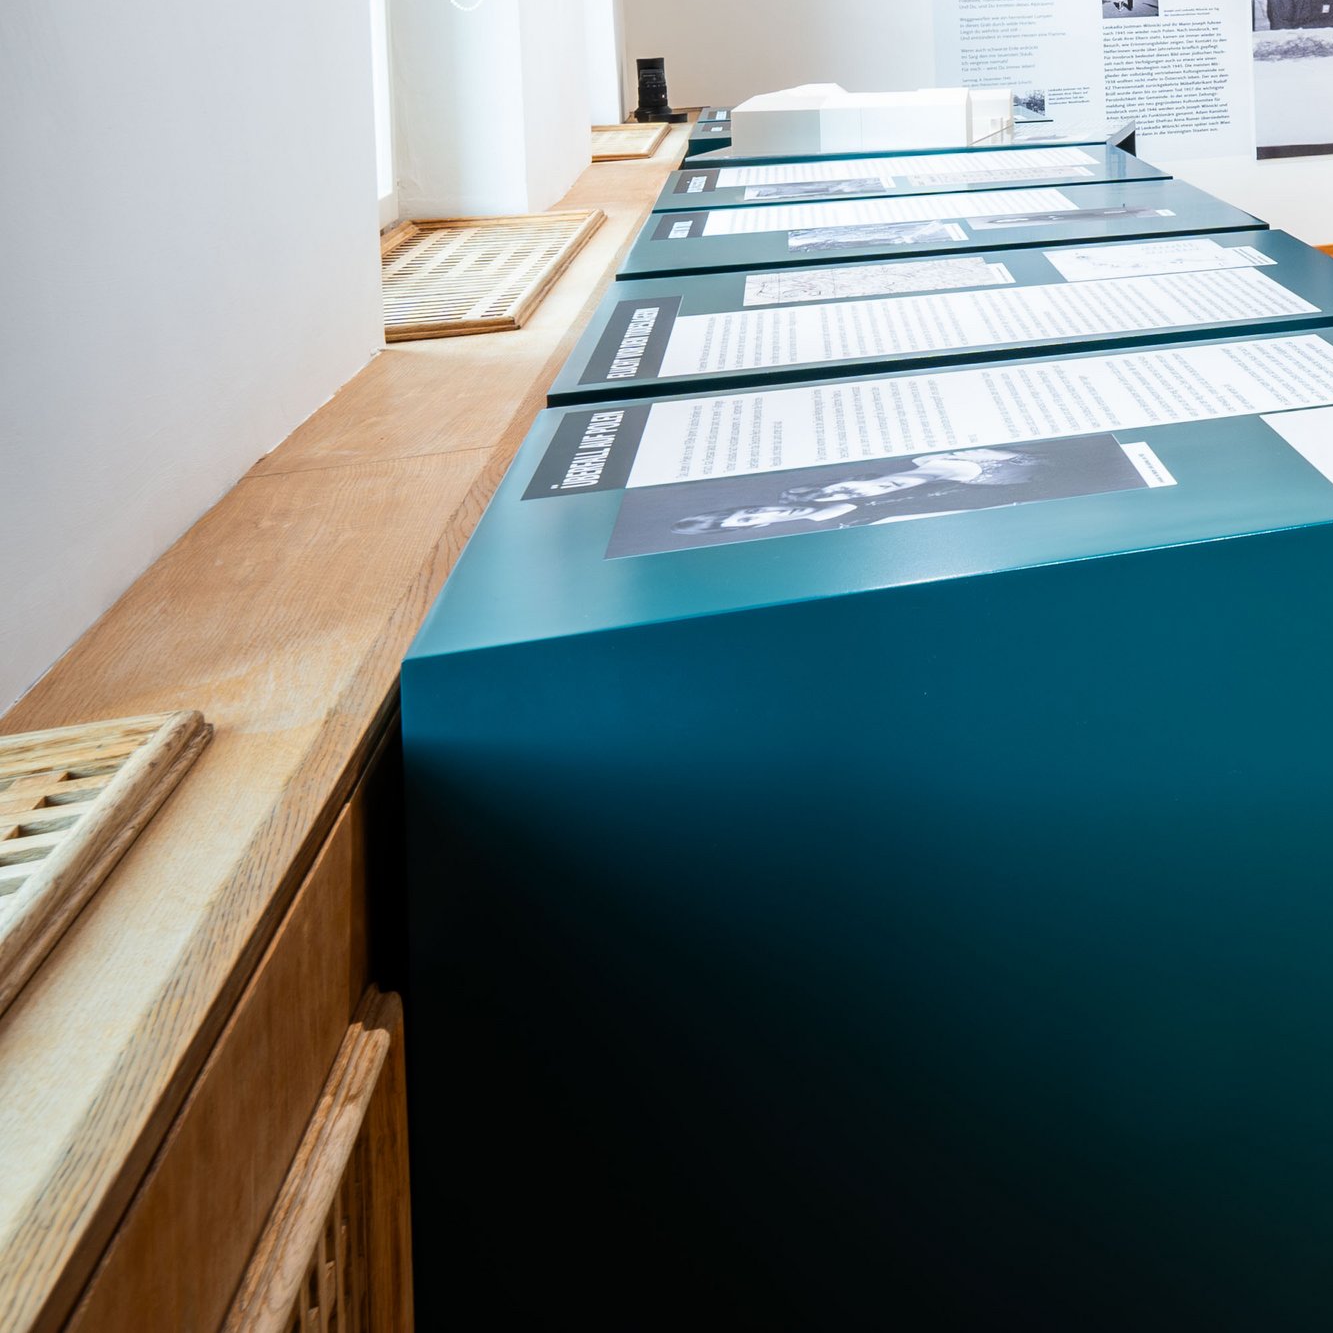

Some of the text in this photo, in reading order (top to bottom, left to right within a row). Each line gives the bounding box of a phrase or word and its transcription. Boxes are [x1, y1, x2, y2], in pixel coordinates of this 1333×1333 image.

[620, 335, 649, 347] DEN
[616, 347, 644, 358] VOR
[606, 357, 641, 379] FLUCHT
[550, 410, 625, 489] ÜBERFALL AUF POLEN
